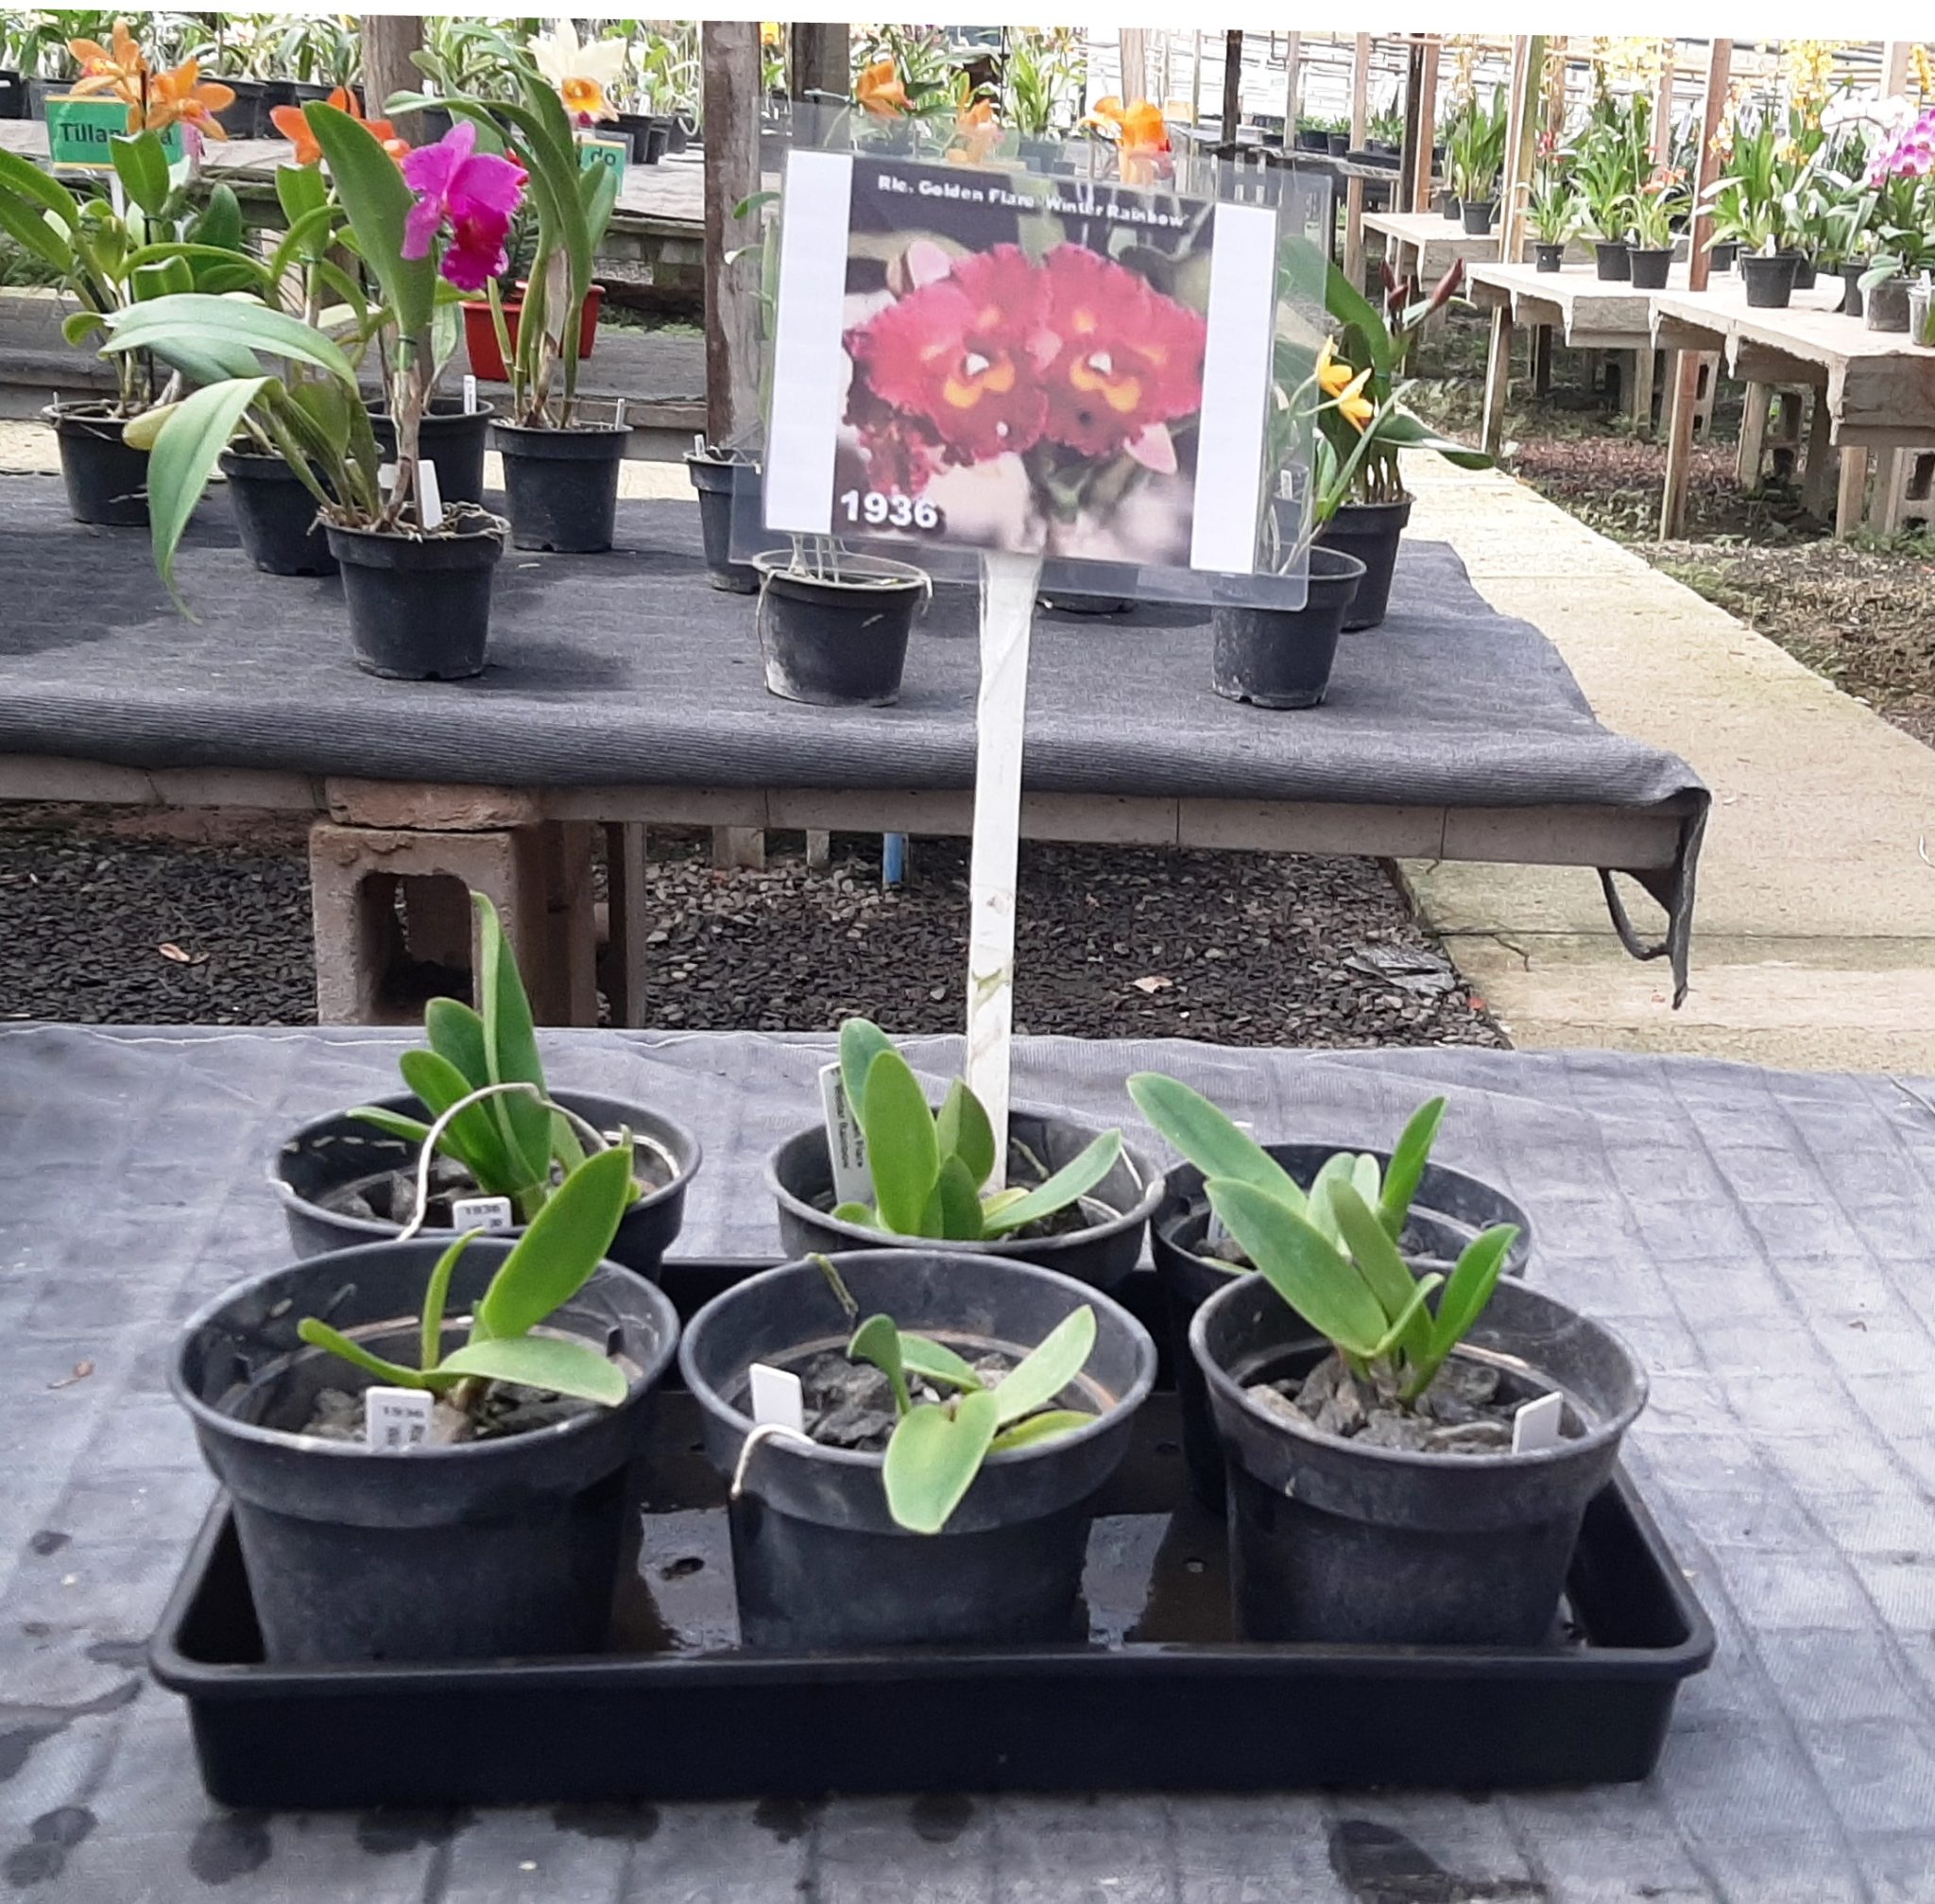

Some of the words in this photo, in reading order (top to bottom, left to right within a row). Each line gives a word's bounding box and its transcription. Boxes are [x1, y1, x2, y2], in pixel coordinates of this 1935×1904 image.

[918, 180, 985, 202] Golden
[988, 187, 1035, 209] Flare
[840, 489, 938, 529] 1936
